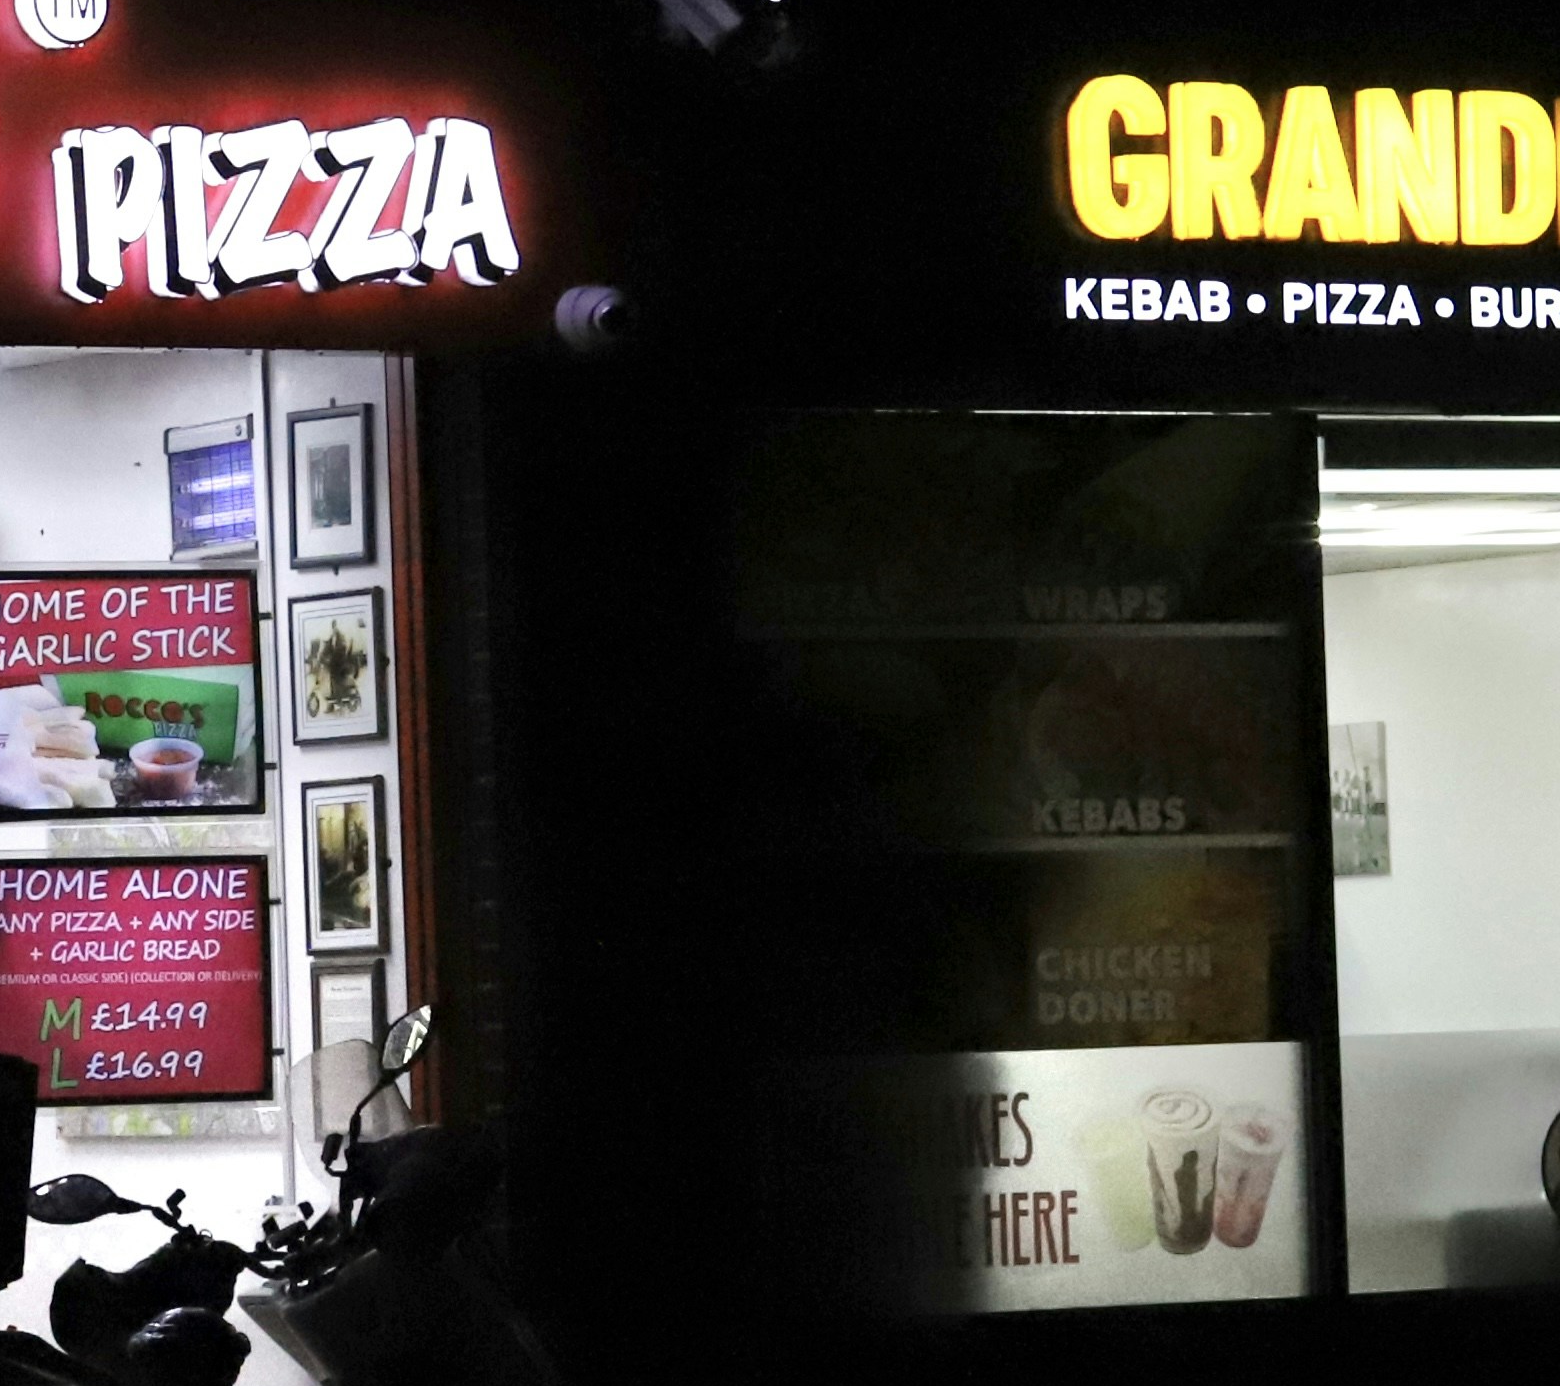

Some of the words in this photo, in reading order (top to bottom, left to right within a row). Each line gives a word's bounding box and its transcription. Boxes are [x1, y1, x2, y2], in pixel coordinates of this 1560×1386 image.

[52, 115, 523, 303] PIZZA
[1064, 277, 1232, 323] KEBAB
[1282, 282, 1421, 327] PIZZA
[100, 586, 150, 619] OF
[160, 581, 236, 616] THE
[131, 625, 237, 663] STICK
[85, 692, 205, 729] ROCCO'S
[1032, 797, 1188, 833] KEBABS
[122, 868, 249, 900] ALONE
[49, 911, 123, 933] PIZZA
[129, 916, 143, 930] +
[148, 910, 199, 932] ANY
[203, 909, 256, 931] SIDE
[29, 946, 43, 961] +
[51, 940, 136, 964] GARLIC
[142, 939, 221, 961] BREAD
[1036, 943, 1212, 981] CHICKEN
[42, 974, 58, 985] OR
[60, 973, 98, 984] CLASSIC
[101, 972, 128, 984] SIDE)
[197, 972, 213, 983] OR
[39, 997, 82, 1042] M
[90, 1000, 209, 1031] £14.99
[1036, 989, 1178, 1024] DONER
[50, 1047, 79, 1090] L
[85, 1050, 204, 1081] £16.99
[984, 1189, 1080, 1266] HERE
